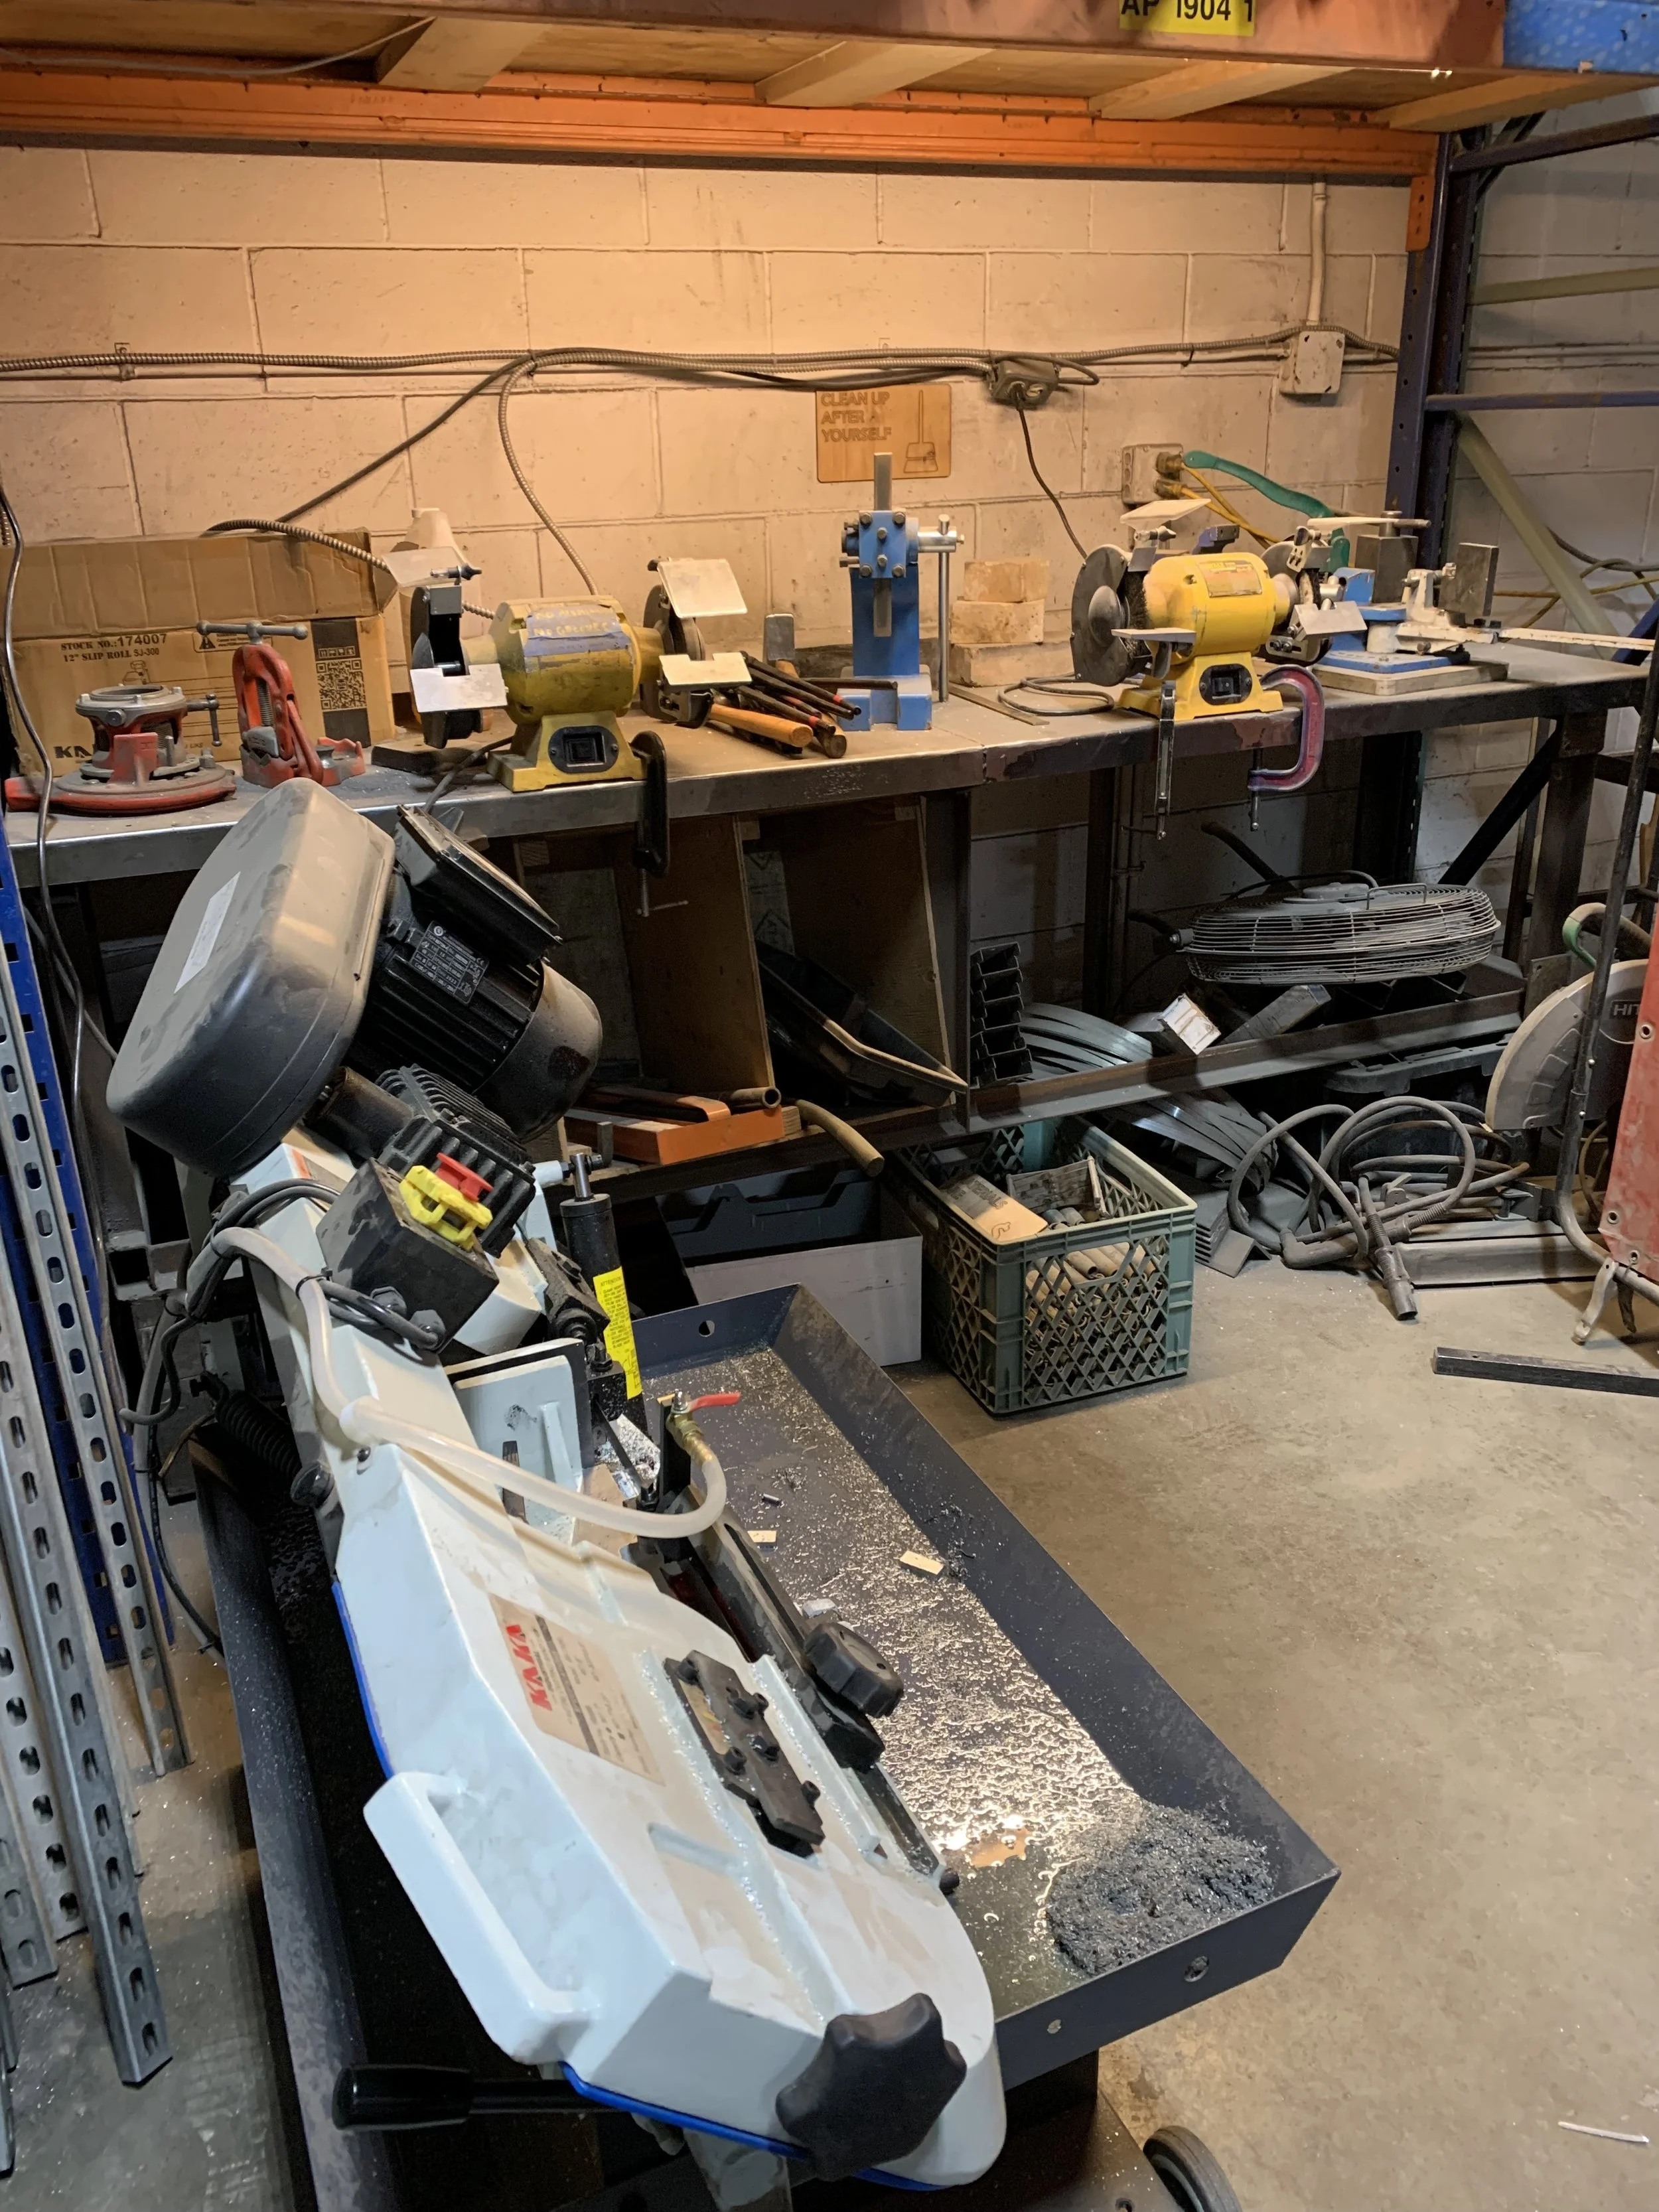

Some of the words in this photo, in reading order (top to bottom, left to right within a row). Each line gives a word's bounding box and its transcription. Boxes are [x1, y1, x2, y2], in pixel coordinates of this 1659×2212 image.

[1177, 0, 1231, 21] 1904
[820, 392, 868, 406] CLEAN
[871, 391, 890, 405] UP
[821, 410, 865, 425] AFTER
[822, 427, 892, 443] YOURSELF
[61, 641, 94, 651] STOCK
[82, 652, 104, 661] SLIP
[107, 650, 132, 660] ROLL
[134, 647, 160, 657] SJ-300
[1613, 1003, 1640, 1015] HIT
[506, 1624, 553, 1712] KAKA
